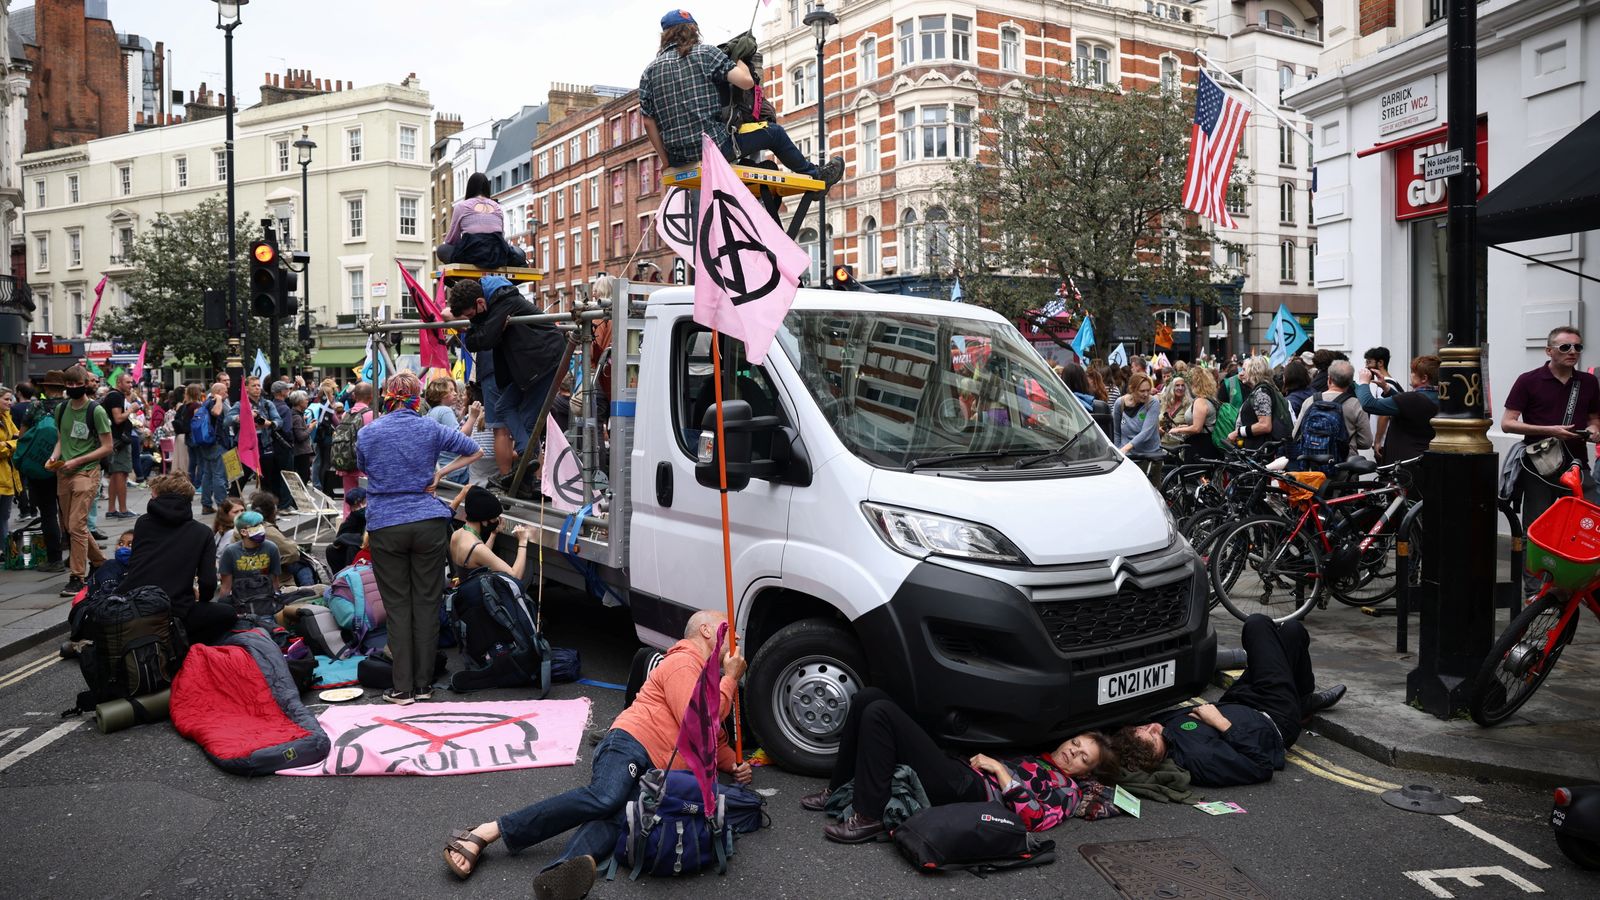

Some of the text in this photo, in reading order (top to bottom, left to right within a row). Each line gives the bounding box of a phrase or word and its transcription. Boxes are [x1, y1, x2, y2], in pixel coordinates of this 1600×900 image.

[1382, 88, 1412, 107] GARRICK
[1382, 95, 1428, 120] STREET WC2
[1437, 155, 1459, 165] loading
[1427, 163, 1459, 177] at any time
[676, 259, 685, 285] AR
[1447, 332, 1454, 344] 2
[1108, 664, 1169, 698] CN21 KWT
